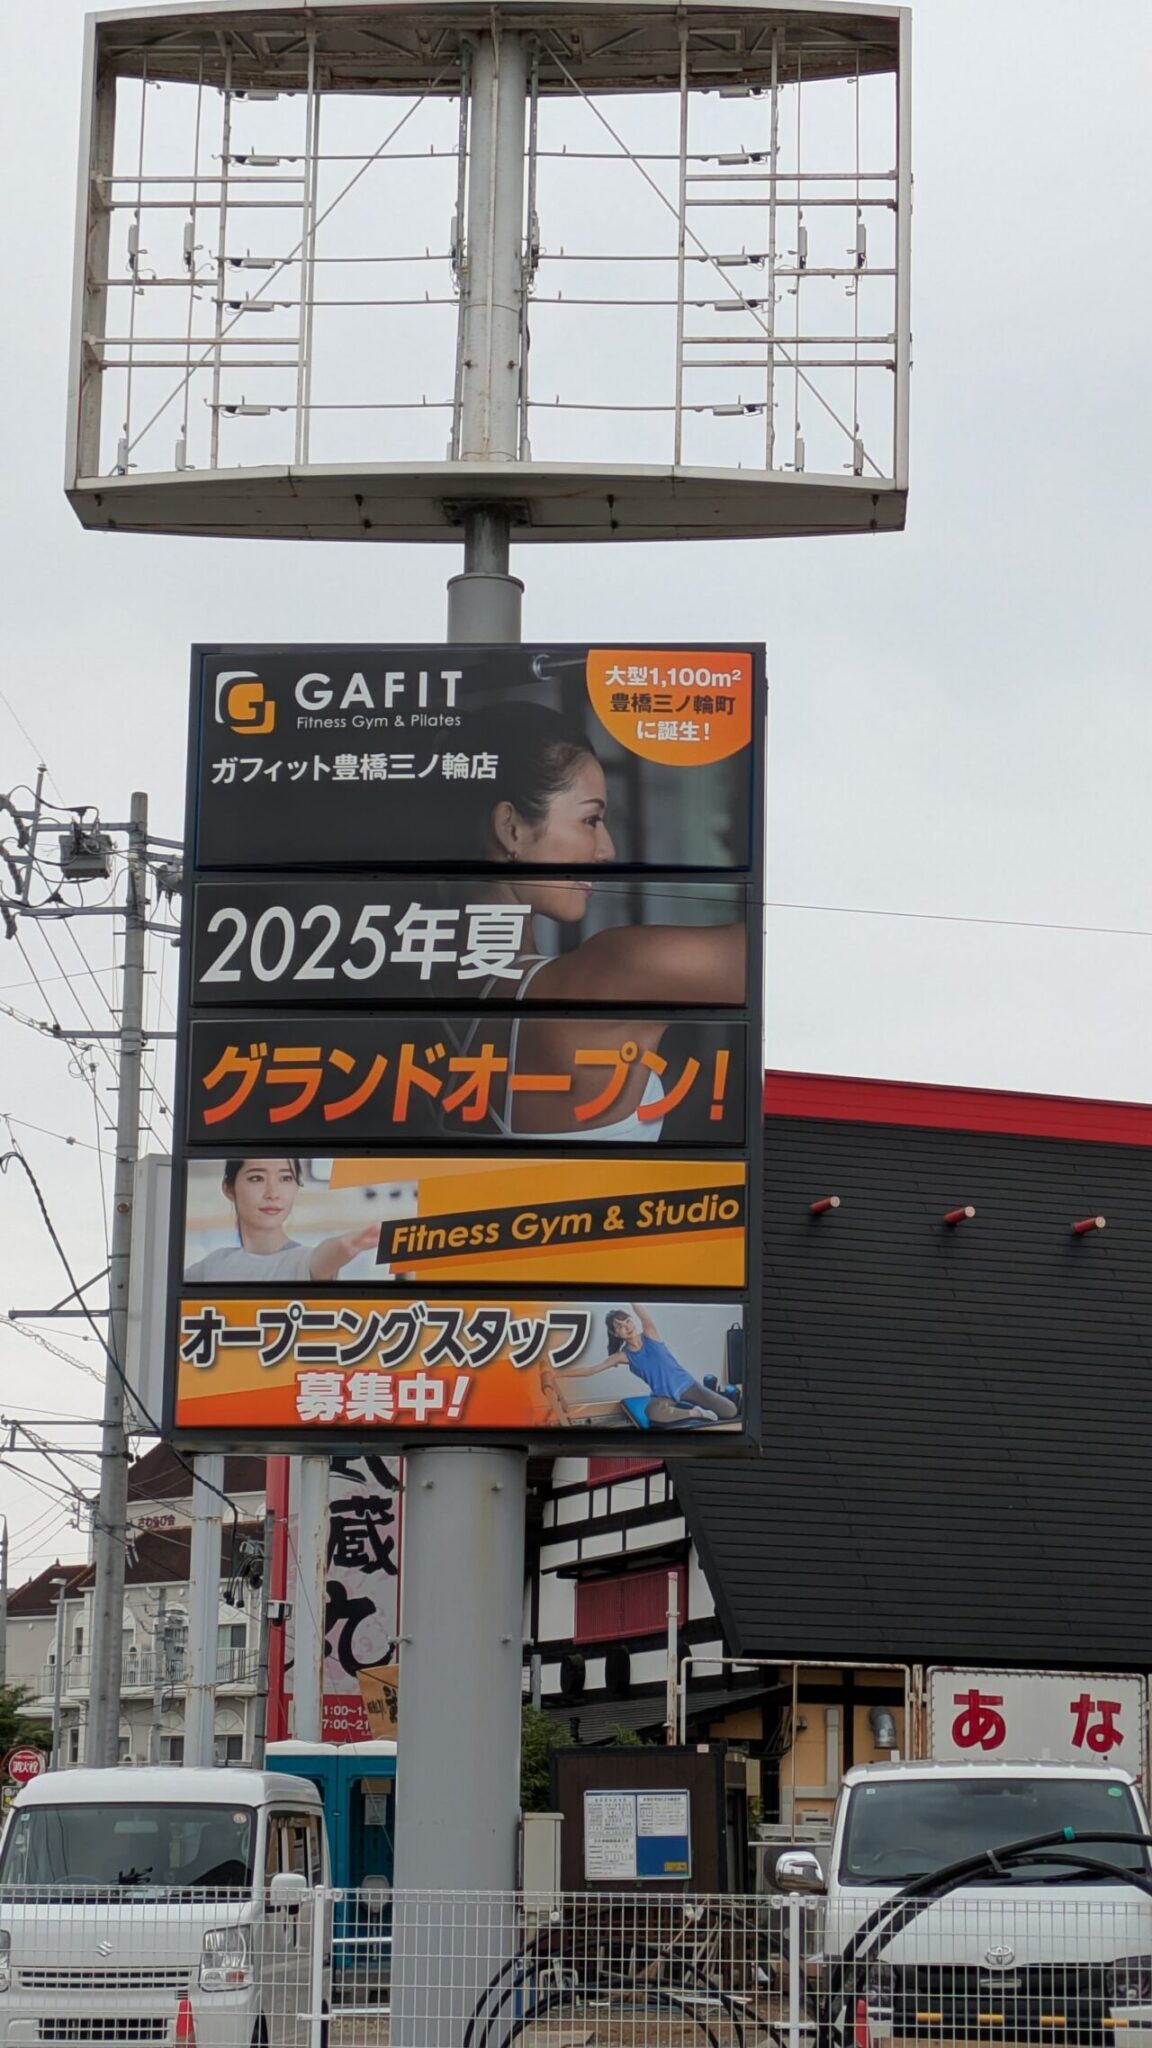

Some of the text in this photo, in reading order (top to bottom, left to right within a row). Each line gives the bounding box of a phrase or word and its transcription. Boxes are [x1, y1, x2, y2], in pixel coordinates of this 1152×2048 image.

[295, 671, 463, 710] GAFIT
[609, 692, 736, 715] 豊橋三ノ輪町
[297, 714, 461, 730] Fitness Gym & Pilates
[211, 752, 499, 784] ガフィット豊橋三ノ輪店
[199, 902, 532, 983] 2025年夏
[391, 1194, 740, 1255] Fitness Gym & Studio
[180, 1302, 591, 1369] オープニングスタッフ
